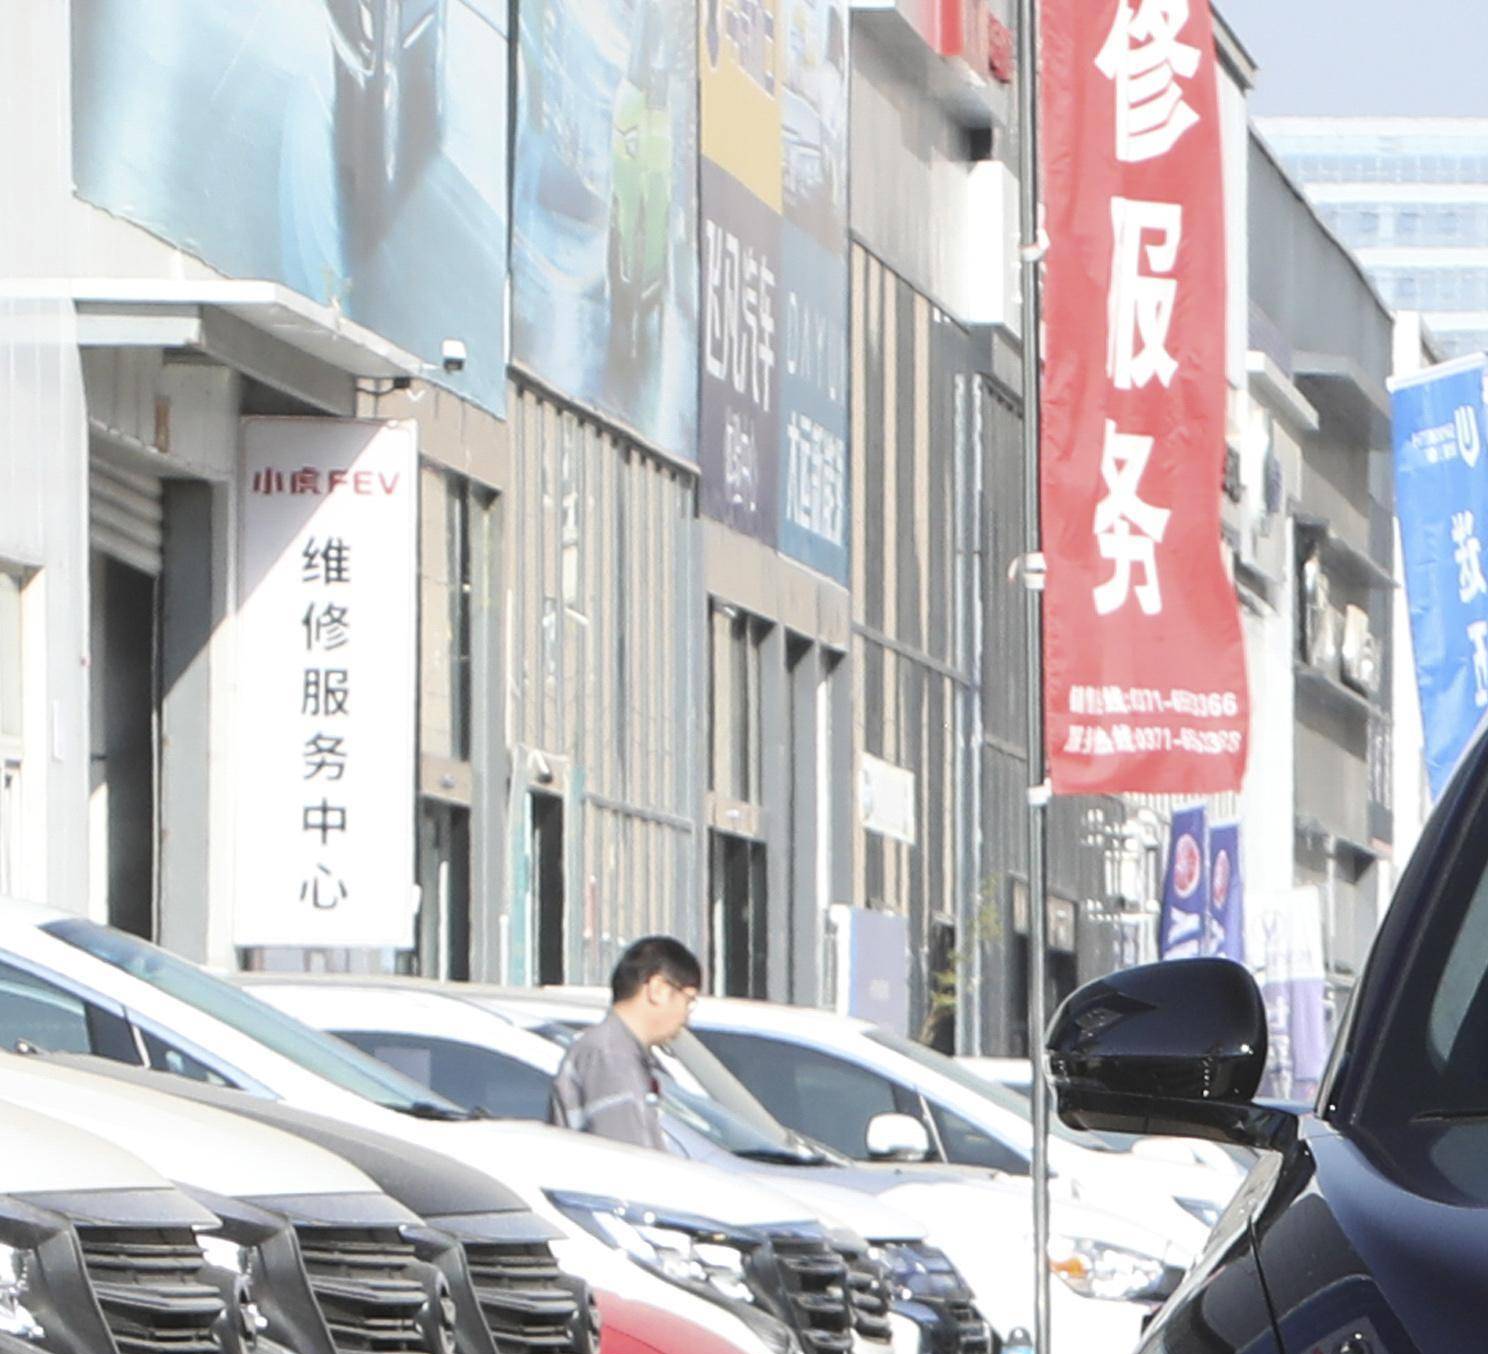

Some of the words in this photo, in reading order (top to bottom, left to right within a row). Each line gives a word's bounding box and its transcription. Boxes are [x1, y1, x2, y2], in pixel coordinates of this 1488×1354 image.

[300, 536, 351, 911] 维修服务中心
